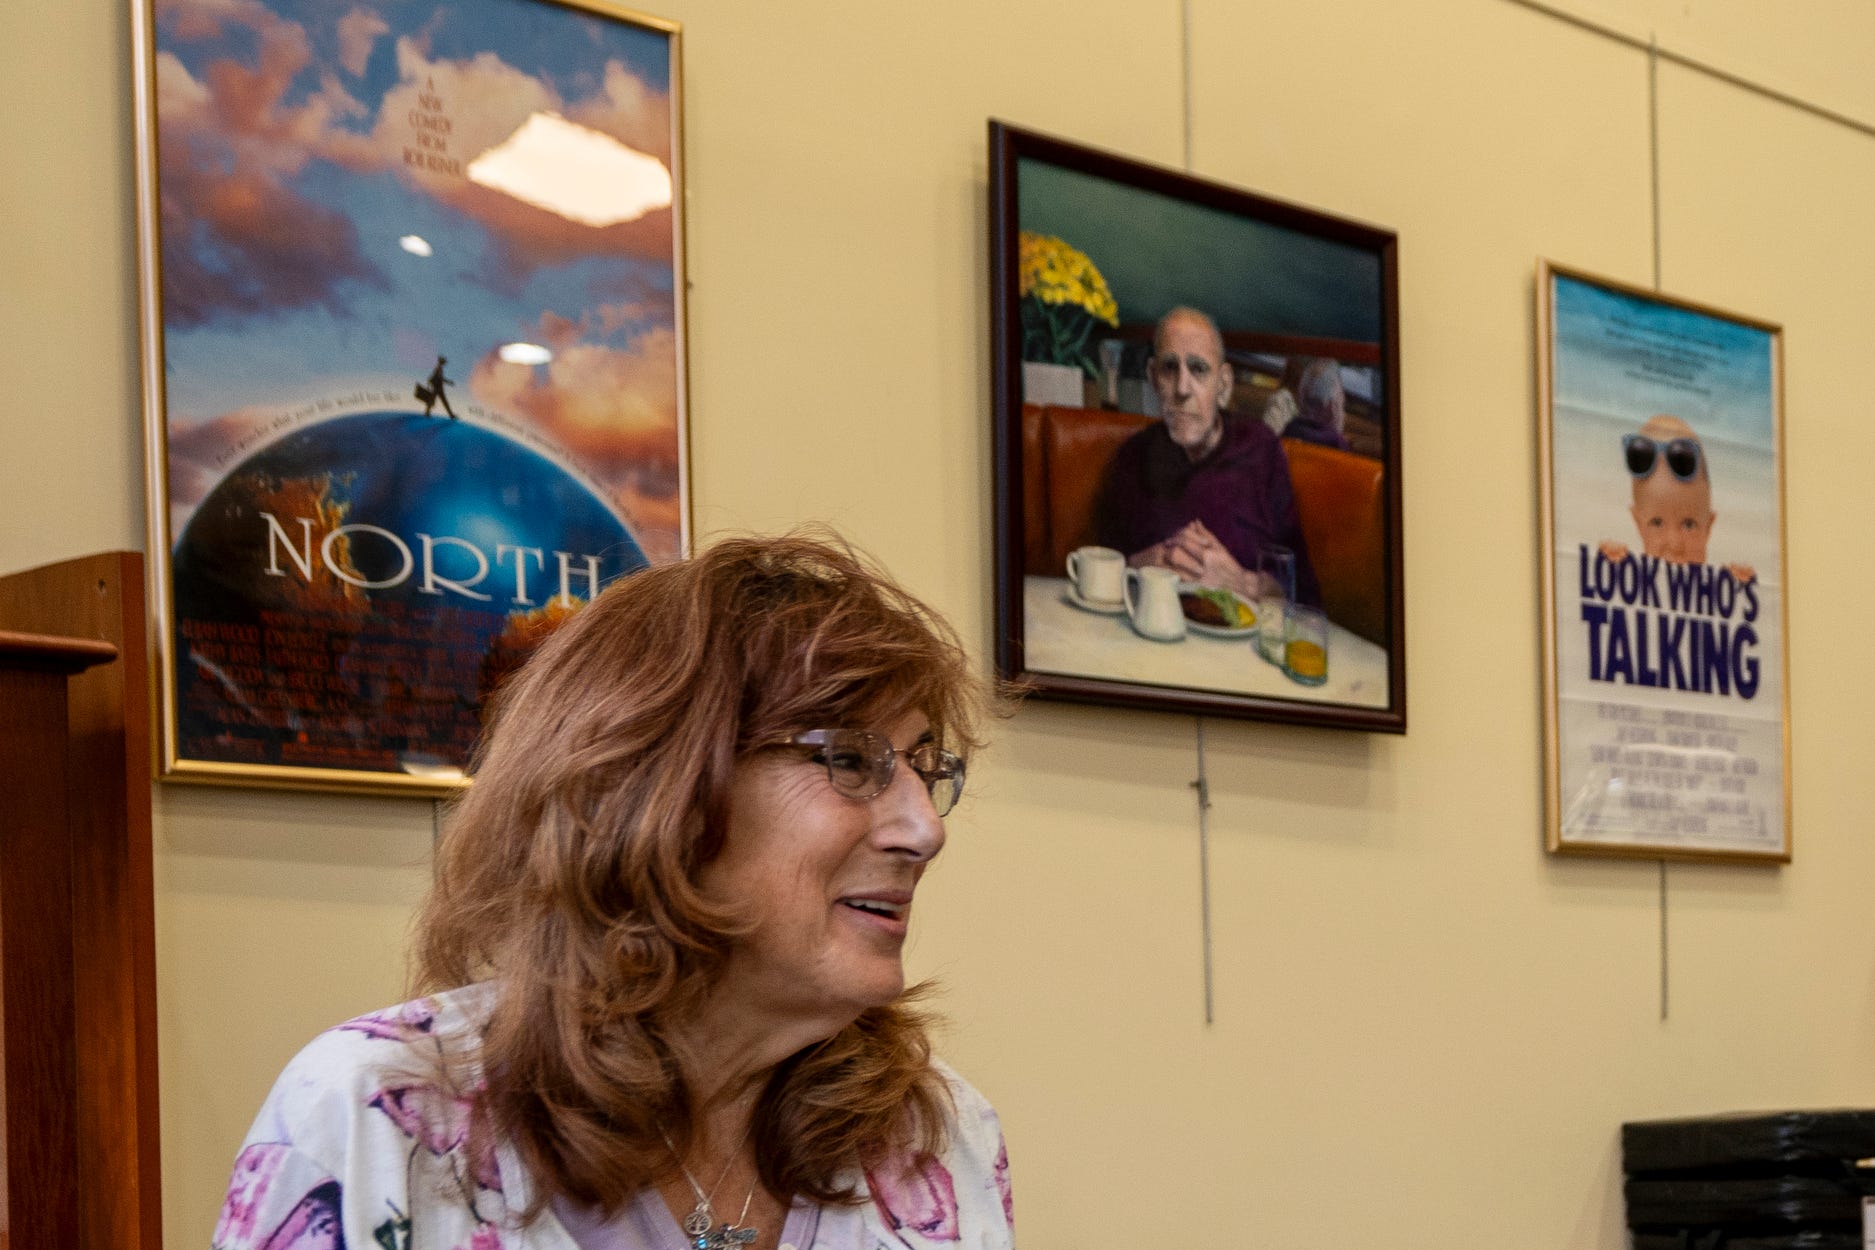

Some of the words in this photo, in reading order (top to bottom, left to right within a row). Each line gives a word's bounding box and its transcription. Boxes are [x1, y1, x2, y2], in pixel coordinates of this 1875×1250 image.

[259, 511, 603, 609] NORTH
[1579, 544, 1662, 609] LOOK
[1665, 561, 1760, 623] WHO'S
[1581, 602, 1761, 700] TALKING
